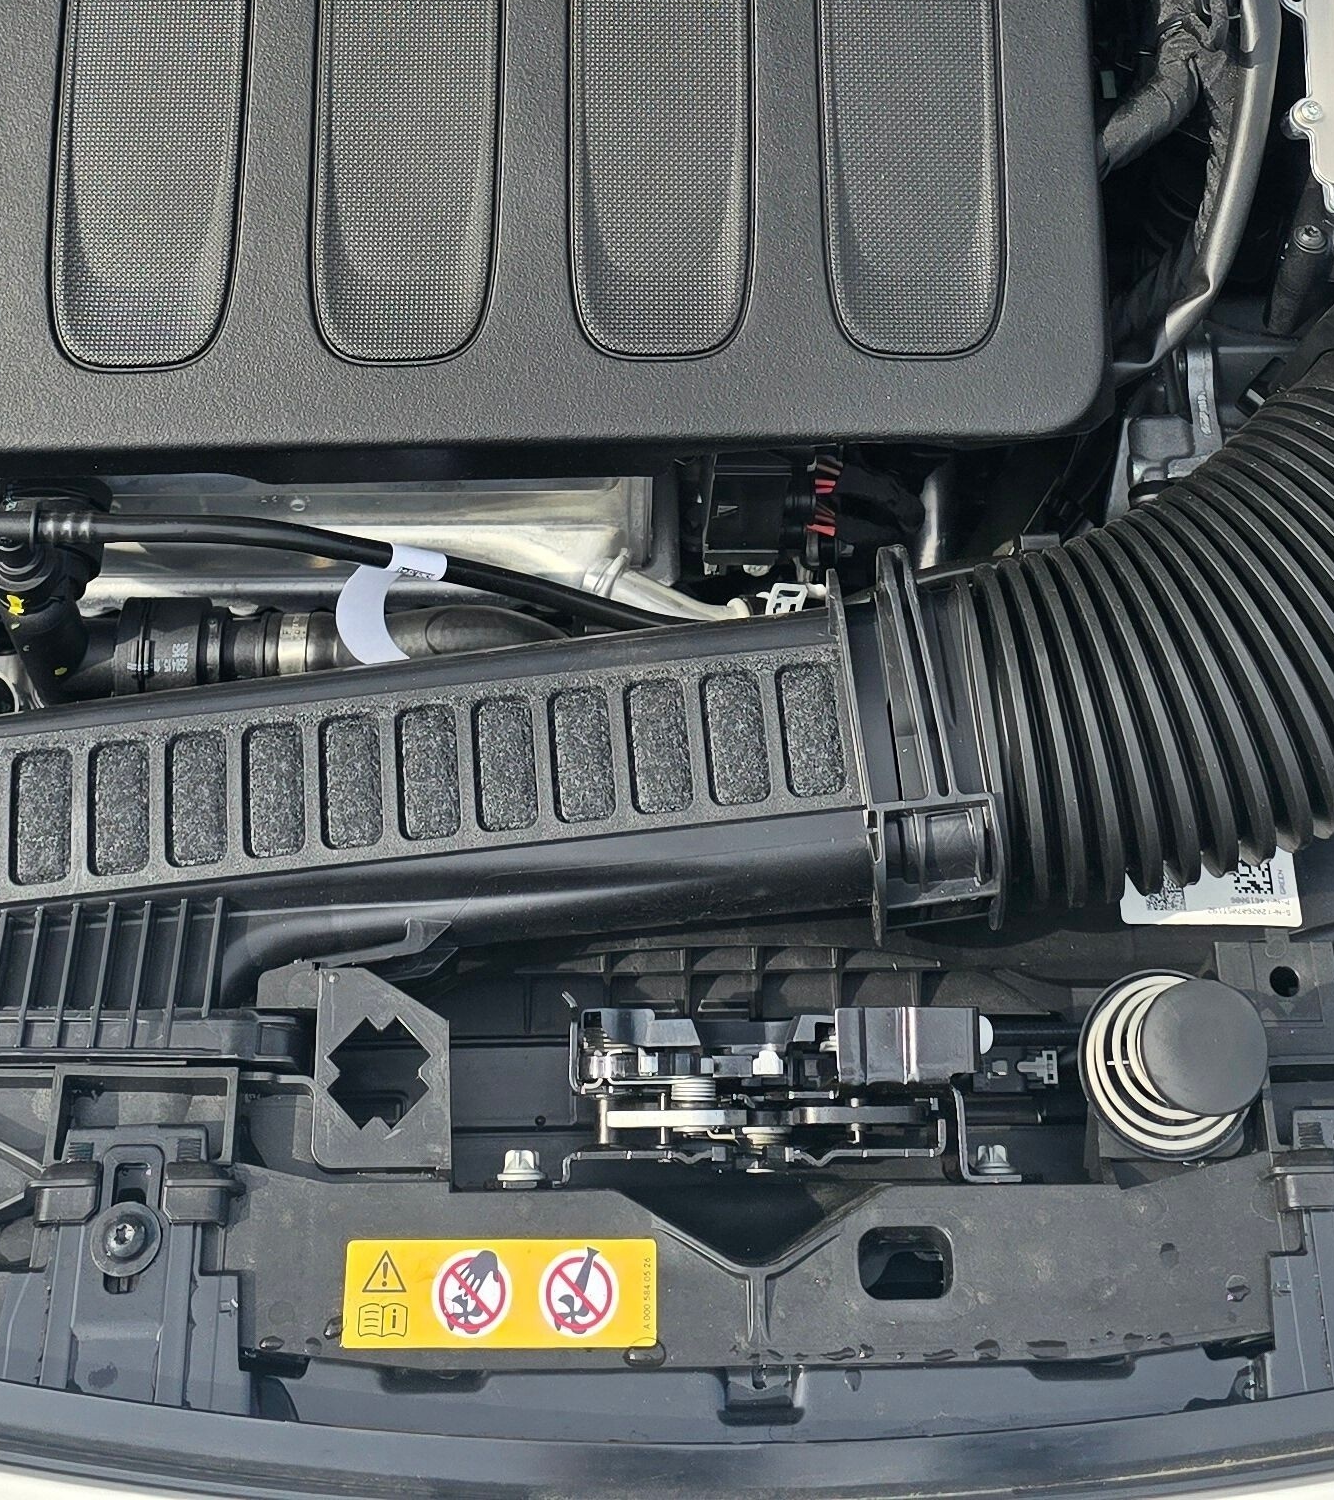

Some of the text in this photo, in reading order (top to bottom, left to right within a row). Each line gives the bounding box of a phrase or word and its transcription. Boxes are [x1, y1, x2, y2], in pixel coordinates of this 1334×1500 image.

[643, 1257, 651, 1268] 26
[643, 1270, 651, 1282] 05
[643, 1284, 651, 1301] 584
[643, 1303, 651, 1321] 000
